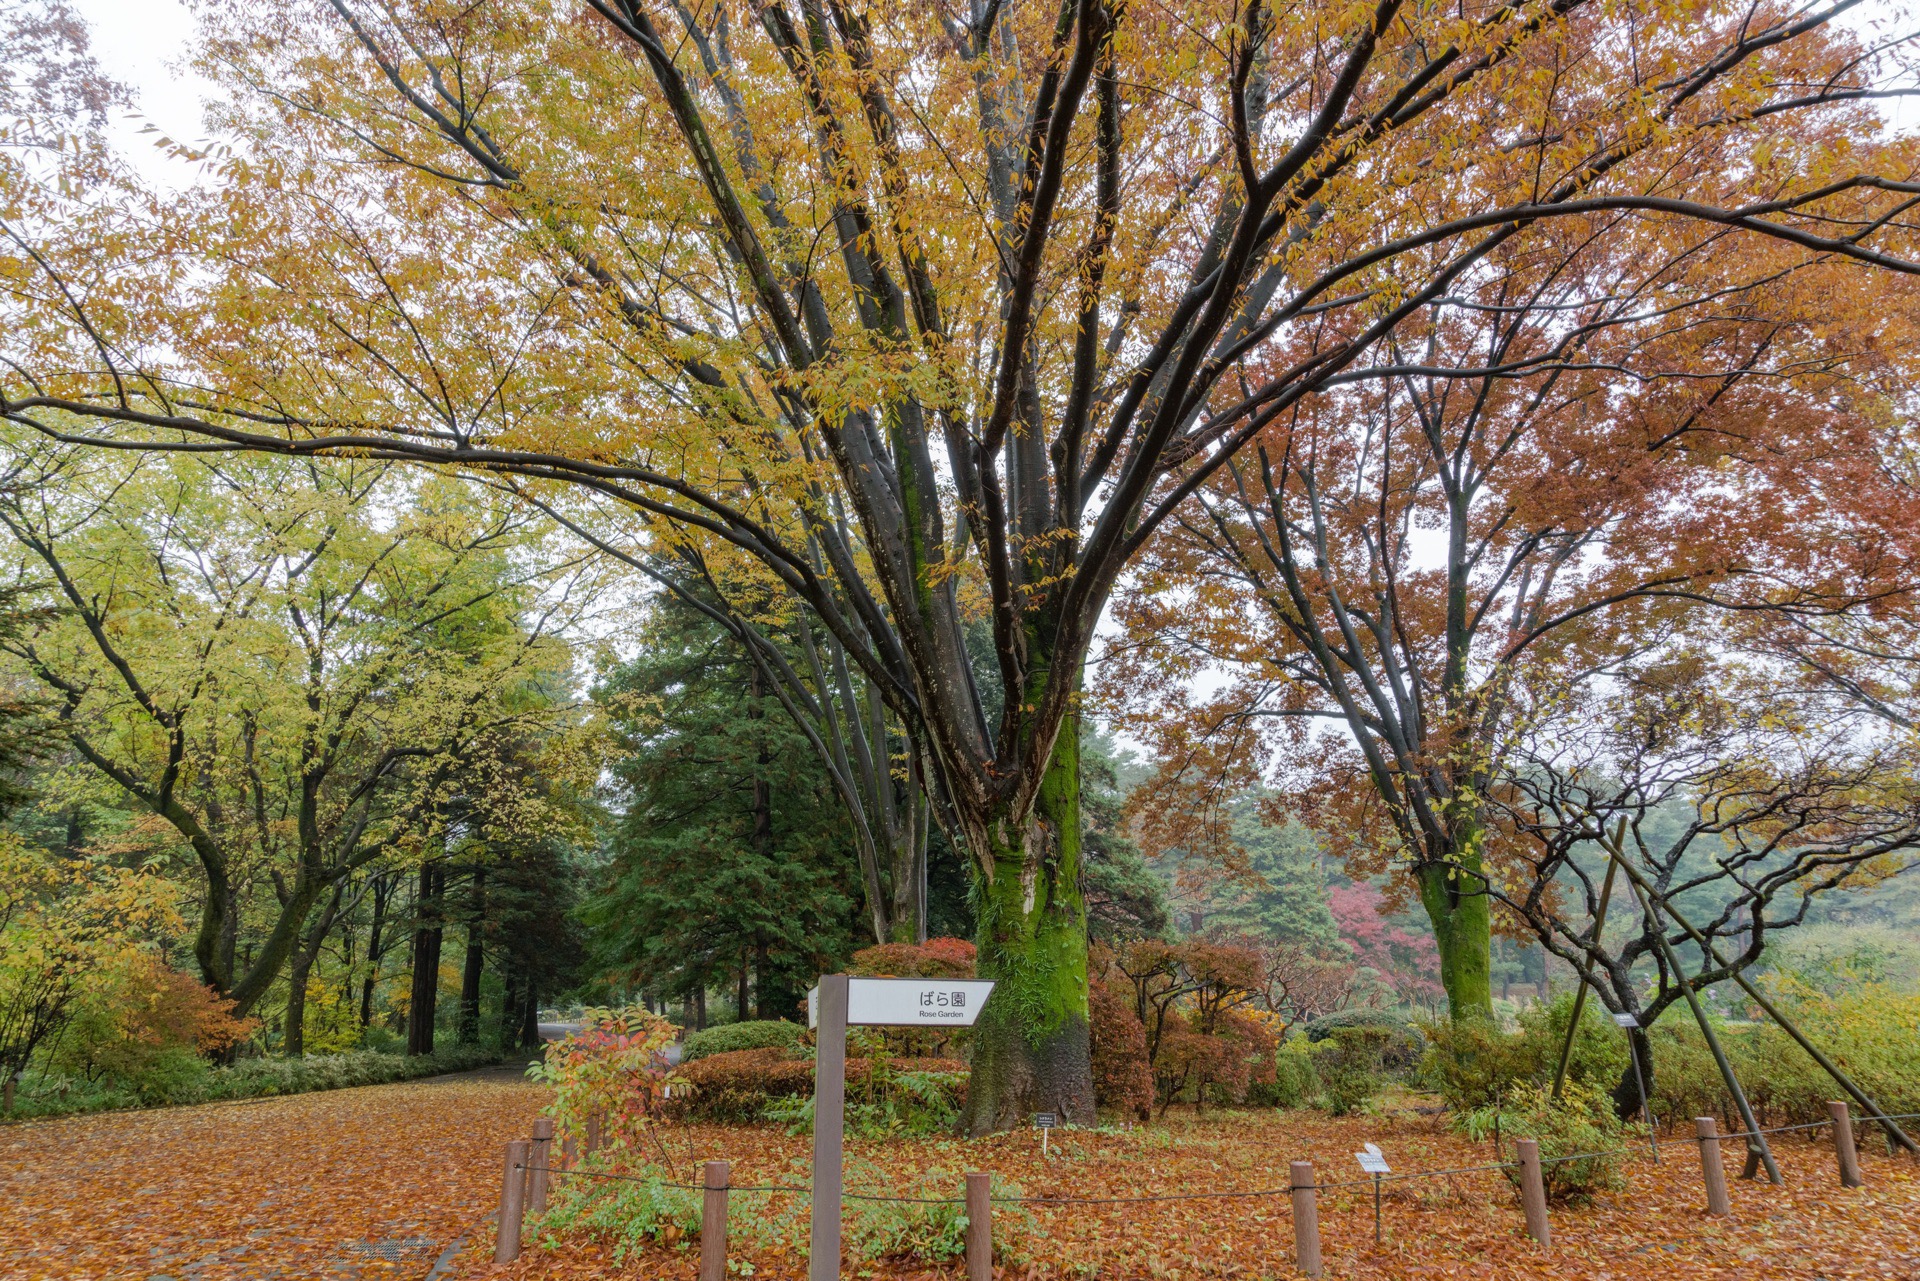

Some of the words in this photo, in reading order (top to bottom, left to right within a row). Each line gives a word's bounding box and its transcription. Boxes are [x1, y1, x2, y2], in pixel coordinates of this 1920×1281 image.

[920, 991, 965, 1007] ばら園
[919, 1010, 937, 1018] Rose
[938, 1010, 963, 1018] Garden
